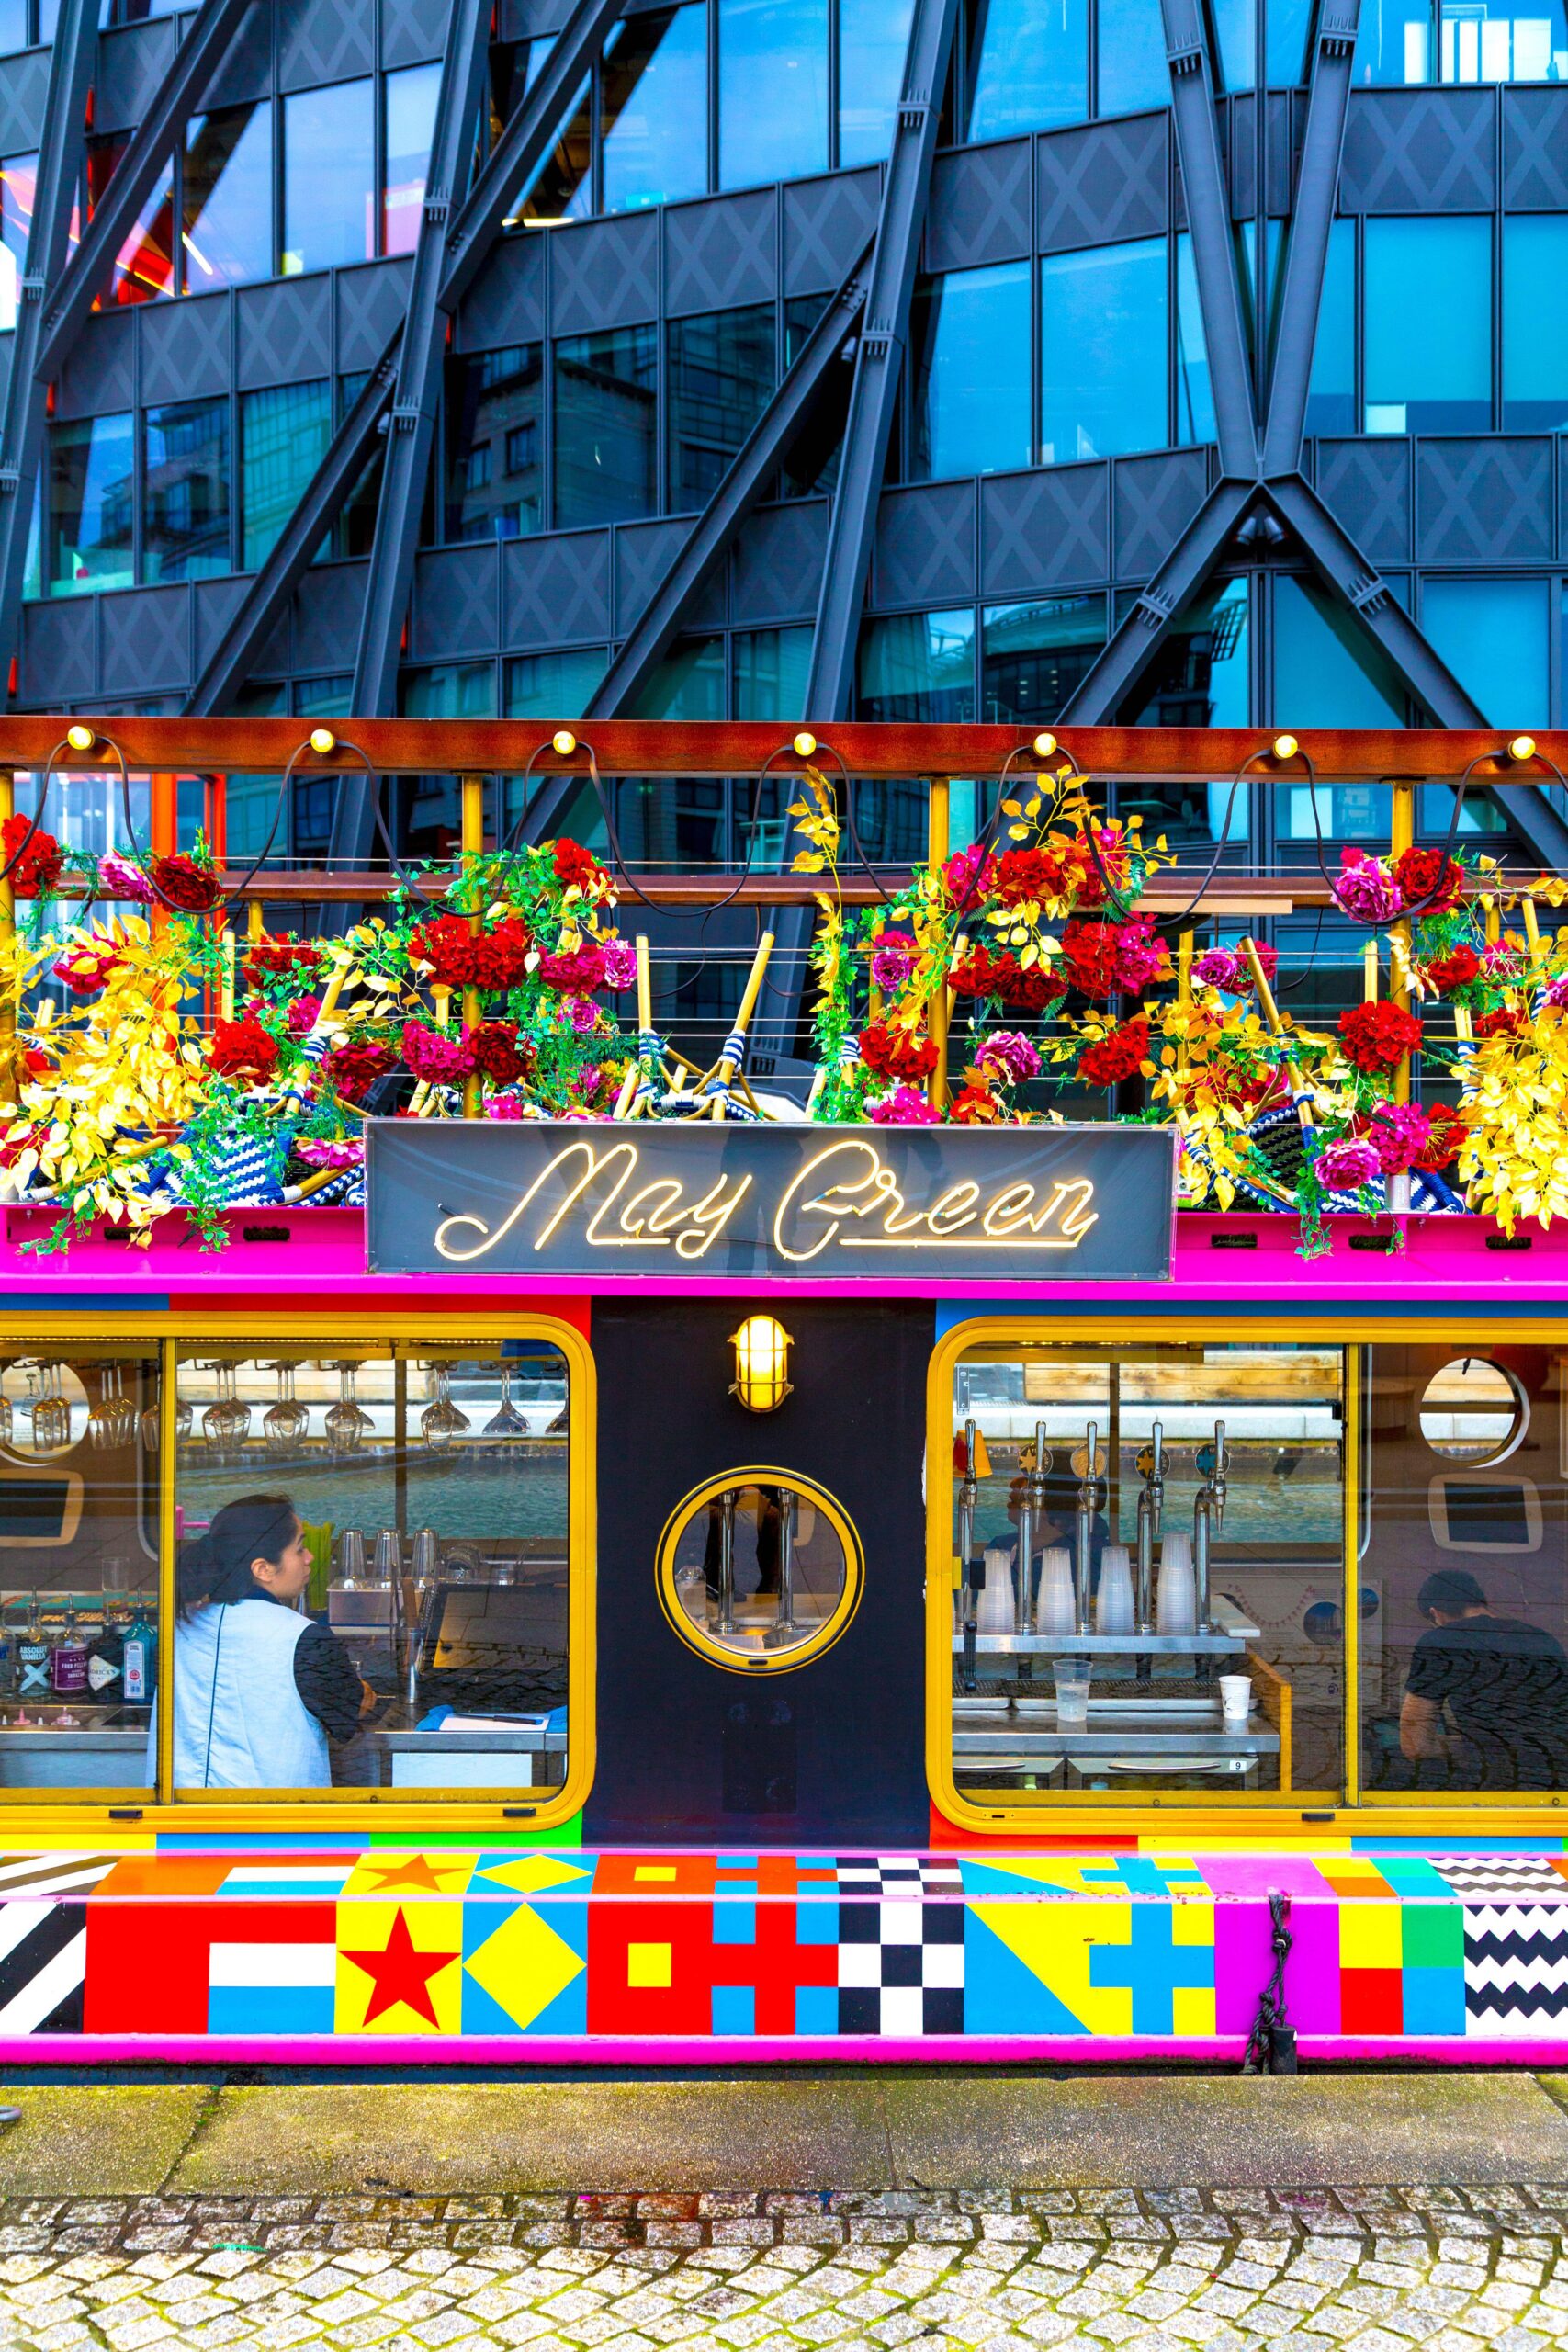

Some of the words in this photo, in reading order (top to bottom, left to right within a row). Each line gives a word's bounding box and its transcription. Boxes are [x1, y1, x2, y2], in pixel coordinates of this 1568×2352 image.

[434, 1142, 752, 1261] May
[774, 1140, 1100, 1261] Green
[1235, 1761, 1242, 1770] 9
